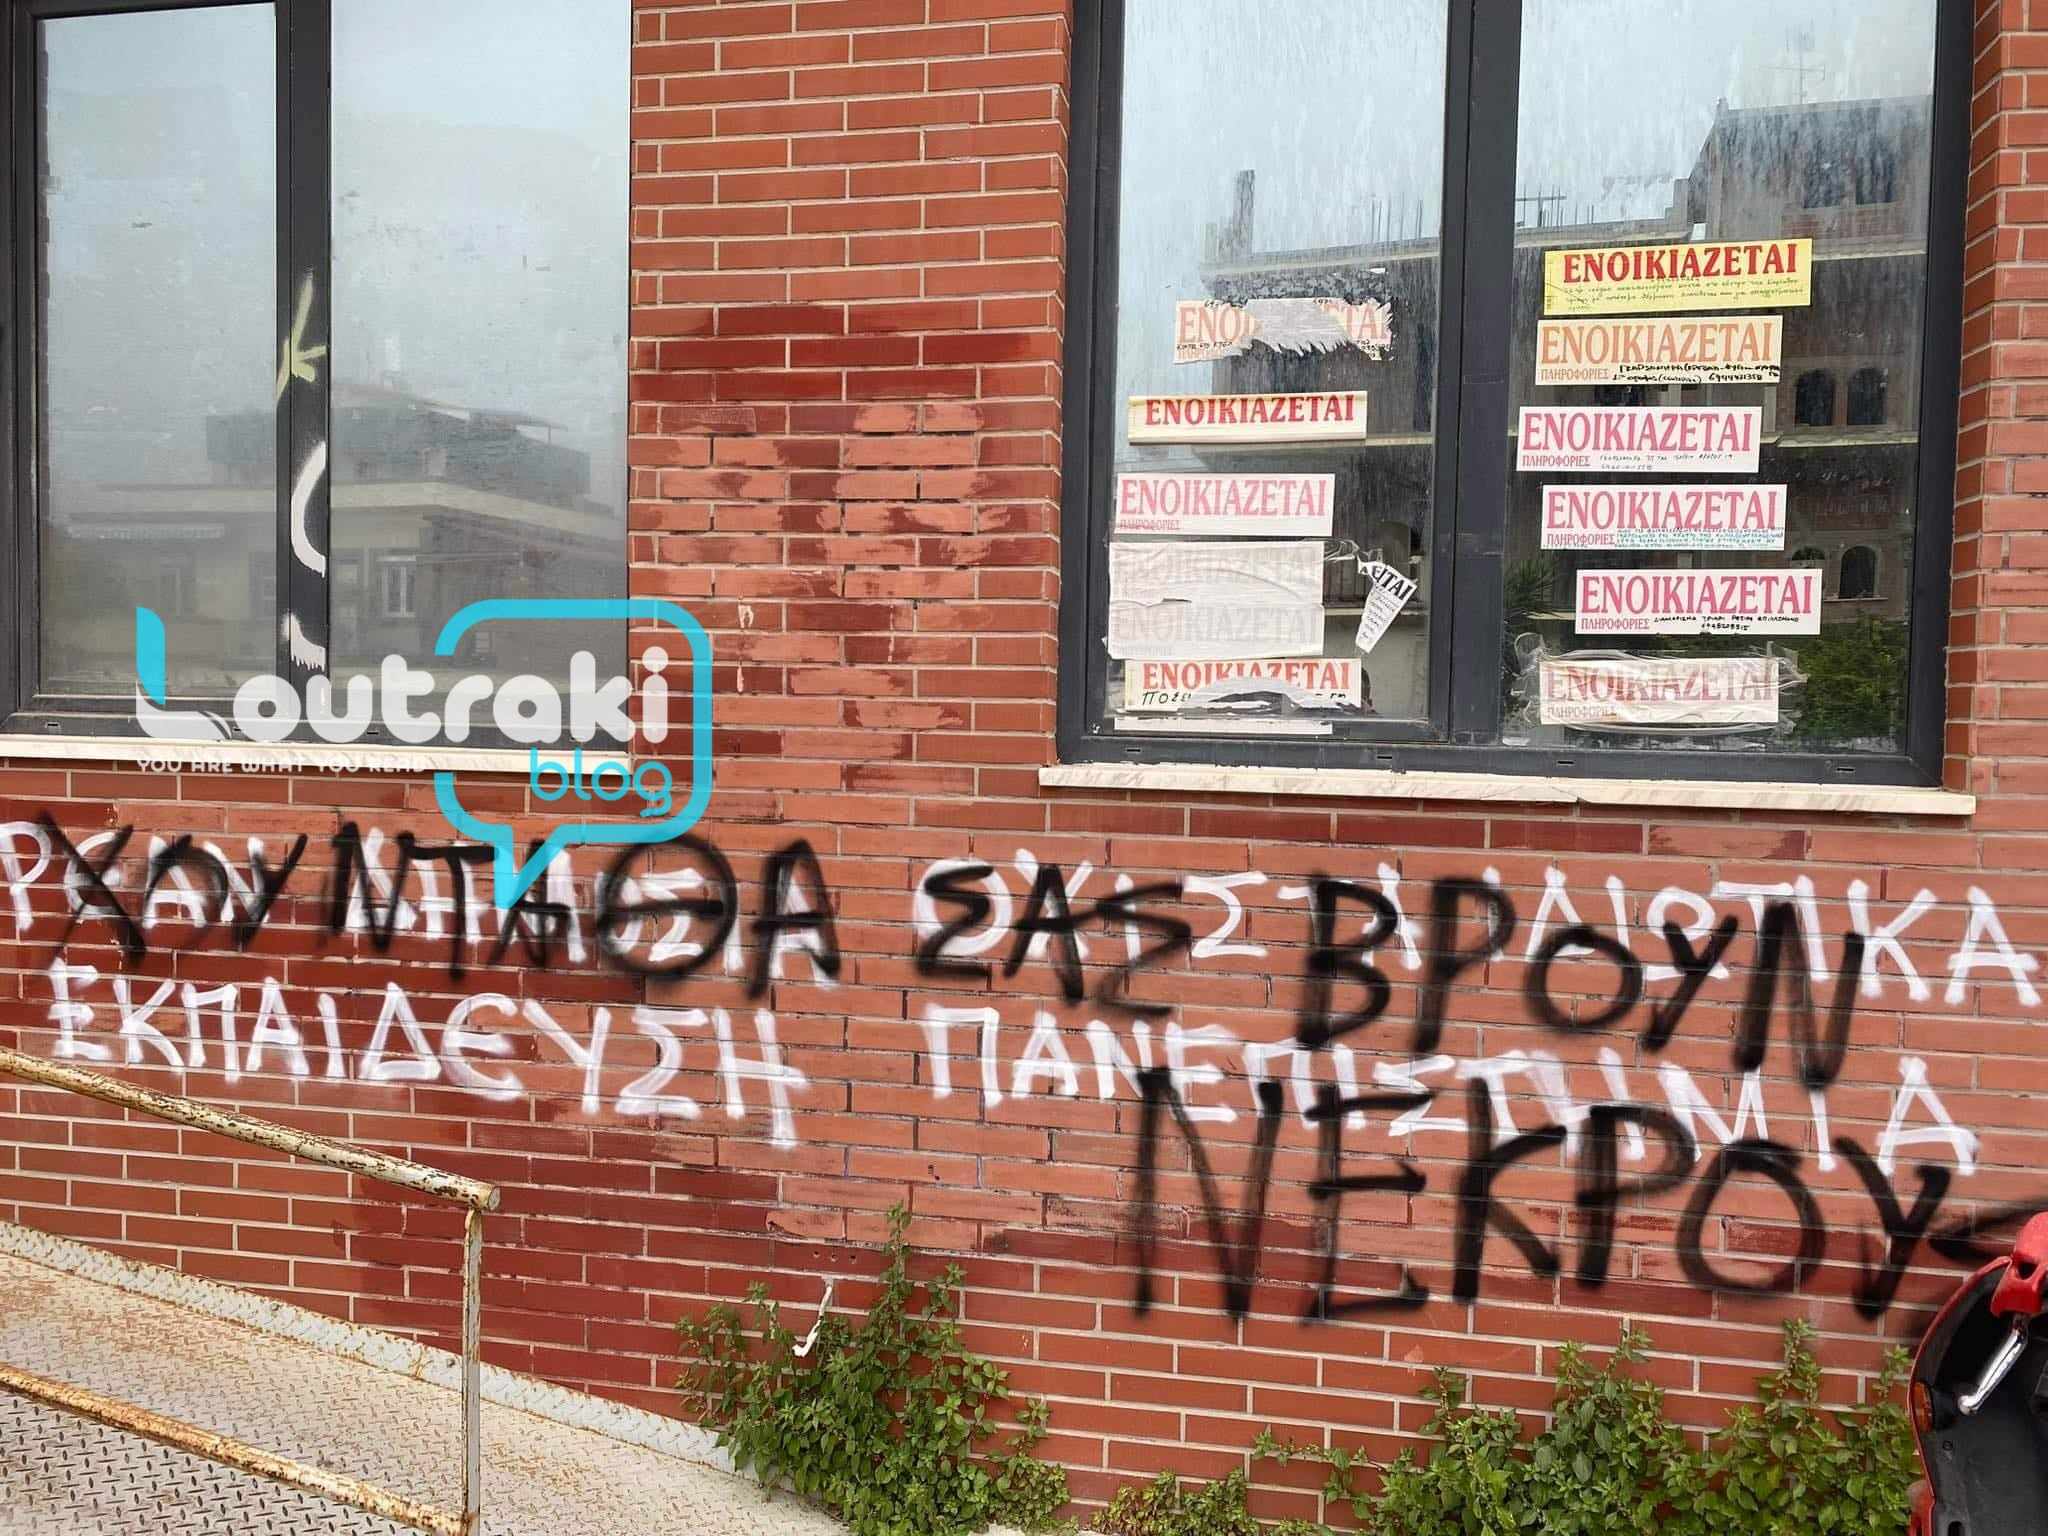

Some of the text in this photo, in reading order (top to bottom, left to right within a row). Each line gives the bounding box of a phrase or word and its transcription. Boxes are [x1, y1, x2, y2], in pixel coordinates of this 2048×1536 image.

[1563, 243, 1797, 283] ΕΝΟΙΚΙΑΖΕΤΑΙ
[1541, 322, 1772, 364] ΕΝΟΙΚΙΑΖΕΤΑΙ
[1541, 368, 1609, 380] ΠΛΗΡΟΦΟΡΙΕΣ
[1145, 394, 1354, 425] ΕΝΟΙΚΙΑΖΕΤΑΙ
[1522, 412, 1752, 452] ΕΝΟΙΚΙΑΖΕΤΑΙ
[1522, 455, 1590, 467] ΠΛΗΡΟΦΟΡΙΕΣ
[1120, 479, 1326, 516] ΕΝΟΙΚΙΑΖΕΤΑΙ
[1547, 491, 1777, 530] ΕΝΟΙΚΙΑΖΕΤΑΙ
[1547, 534, 1615, 545] ΠΛΗΡΟΦΟΡΙΕΣ
[1581, 575, 1812, 614] ΕΝΟΙΚΙΑΖΕΤΑΙ
[1581, 618, 1650, 630] ΠΛΗΡΟΦΟΡΙΕΣ
[914, 864, 1192, 1010] ΣΑΣ
[1295, 868, 1866, 1092] ΒΡΟΥΝ
[48, 954, 812, 1150] ΕΚΠΑΙΔΕΥΣΗ
